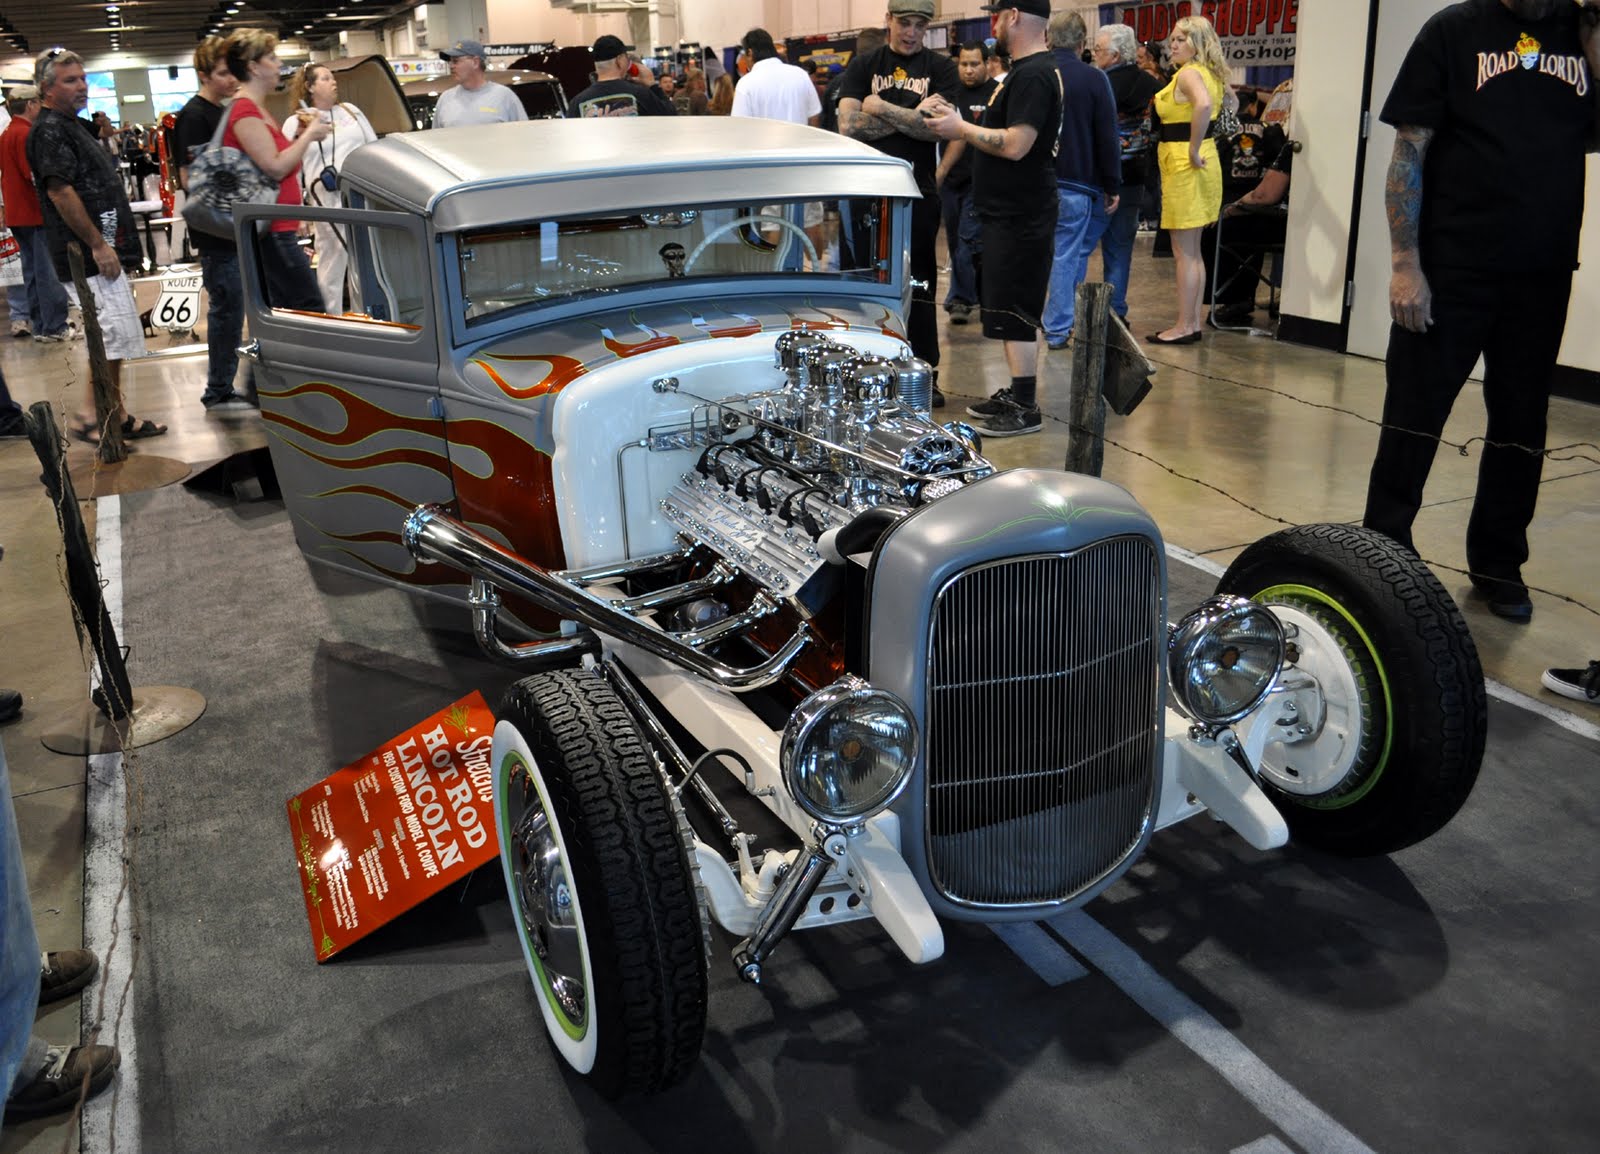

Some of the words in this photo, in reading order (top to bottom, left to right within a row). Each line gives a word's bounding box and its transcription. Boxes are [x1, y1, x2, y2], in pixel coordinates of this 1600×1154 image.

[483, 46, 525, 55] Rodders
[1243, 38, 1268, 46] Since
[1272, 37, 1292, 45] 1984
[871, 74, 895, 95] ROAD
[1476, 51, 1518, 92] ROAD
[1538, 53, 1588, 96] LORDS
[167, 277, 199, 288] ROUTE
[160, 296, 191, 323] 66
[382, 750, 396, 768] 1930
[387, 766, 407, 796] CUSTOM
[421, 723, 459, 783] HOT
[444, 777, 487, 849] ROD
[395, 736, 465, 870] LINCOLN
[397, 793, 415, 815] FORD
[404, 813, 425, 842] MODEL
[415, 841, 428, 851] A
[417, 848, 440, 879] COUPE
